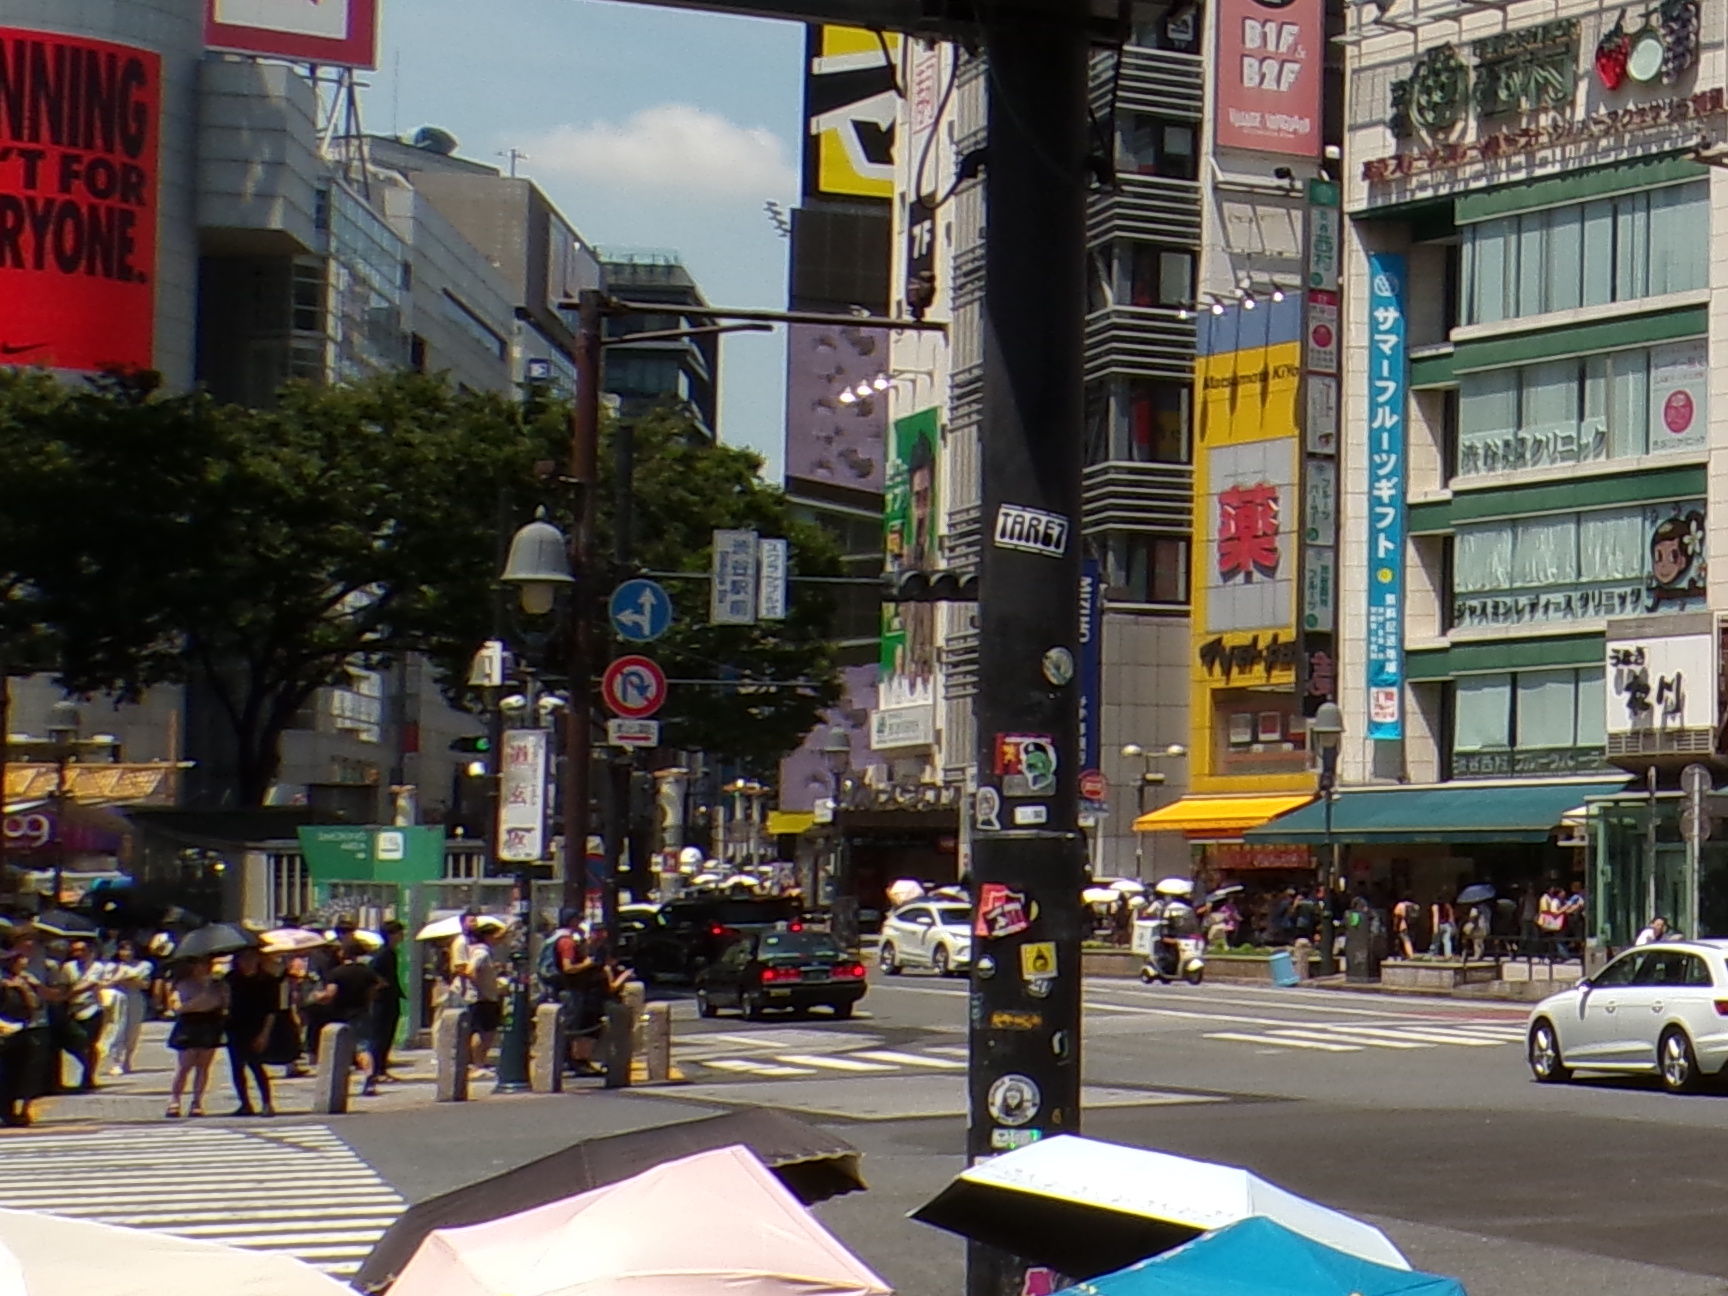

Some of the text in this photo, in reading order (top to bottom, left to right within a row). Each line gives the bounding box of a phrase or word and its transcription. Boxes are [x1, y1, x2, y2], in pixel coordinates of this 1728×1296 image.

[1243, 17, 1299, 54] B1F
[1241, 55, 1301, 93] B2F
[58, 153, 148, 207] FOR
[1371, 306, 1401, 559] サマーフルーツギフト
[1216, 480, 1281, 585] 薬
[1079, 576, 1093, 644] MIZUHO
